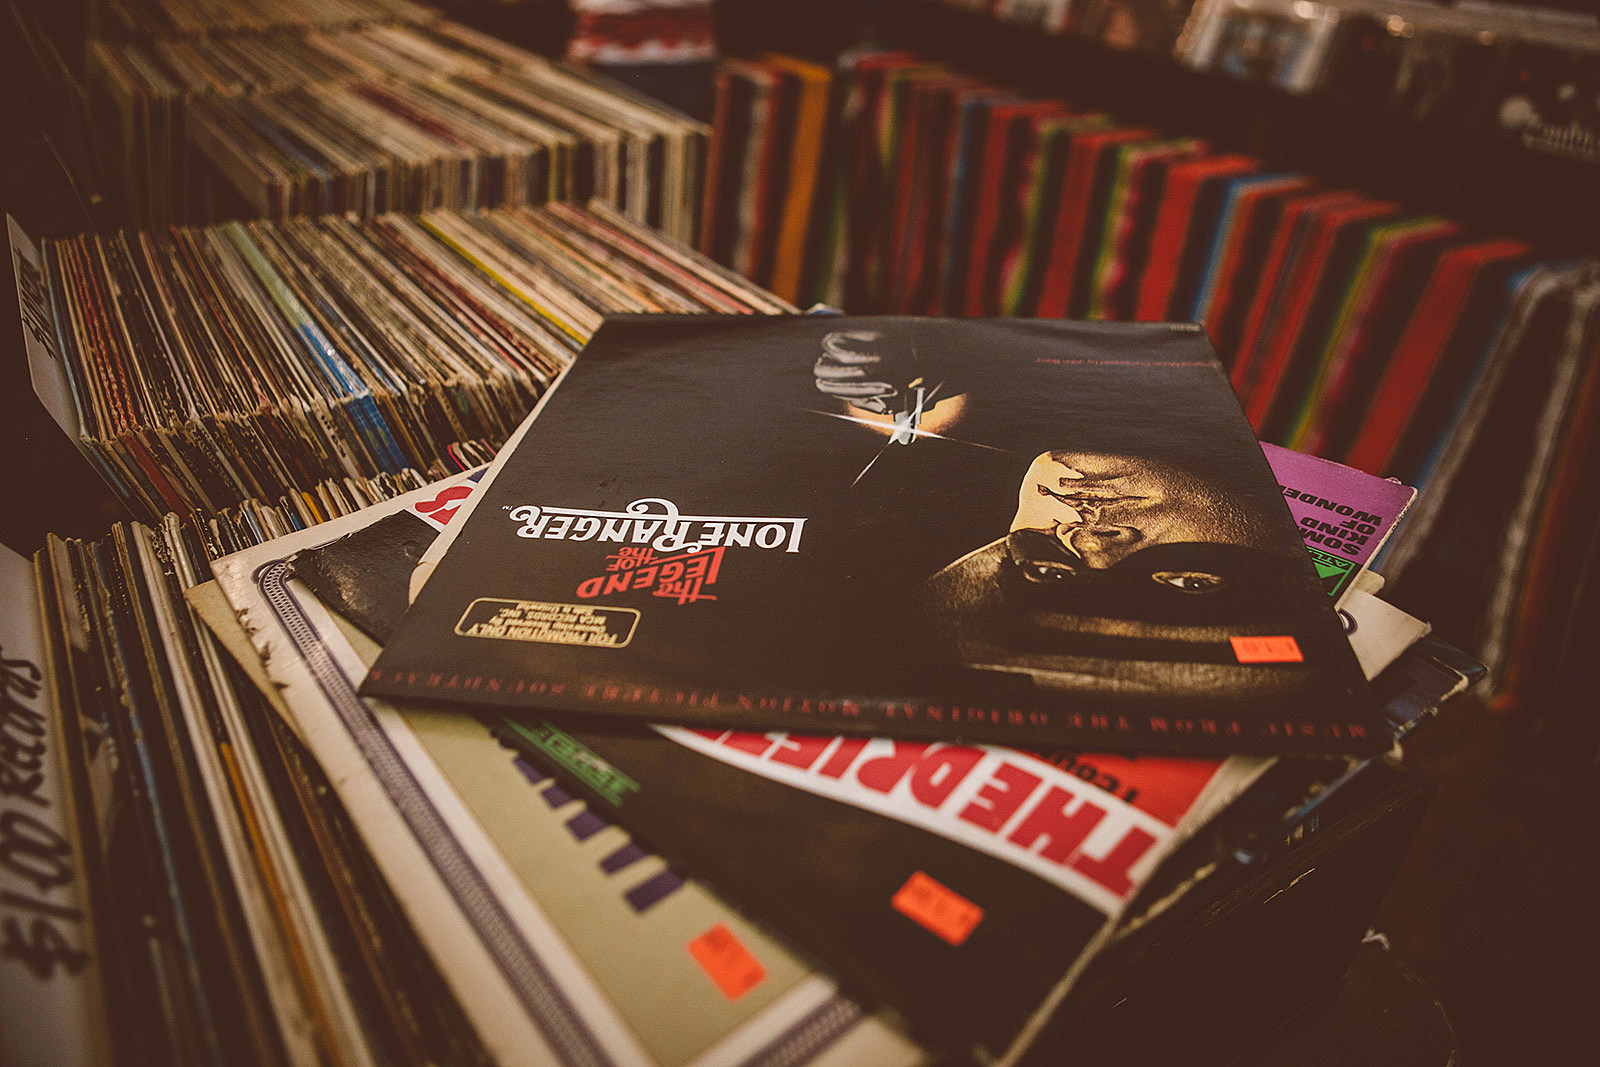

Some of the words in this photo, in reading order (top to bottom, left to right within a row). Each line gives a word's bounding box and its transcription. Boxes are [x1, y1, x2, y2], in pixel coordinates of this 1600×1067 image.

[509, 497, 702, 554] RANGER
[700, 517, 808, 553] LONE
[1300, 517, 1369, 545] KIND
[1340, 520, 1376, 535] OF
[1300, 528, 1361, 556] SOM
[1307, 550, 1349, 567] ATL
[576, 546, 726, 599] LEGEND
[466, 622, 508, 637] ONLY
[579, 615, 607, 625] MCA
[507, 624, 589, 643] PROMOTION
[588, 632, 618, 645] FOR
[582, 684, 719, 708] PICTURE
[737, 695, 859, 716] MOTION
[885, 702, 1049, 725] ORIGINAL
[1068, 712, 1129, 731] THE
[1150, 716, 1240, 735] FROM
[957, 762, 1158, 897] THE
